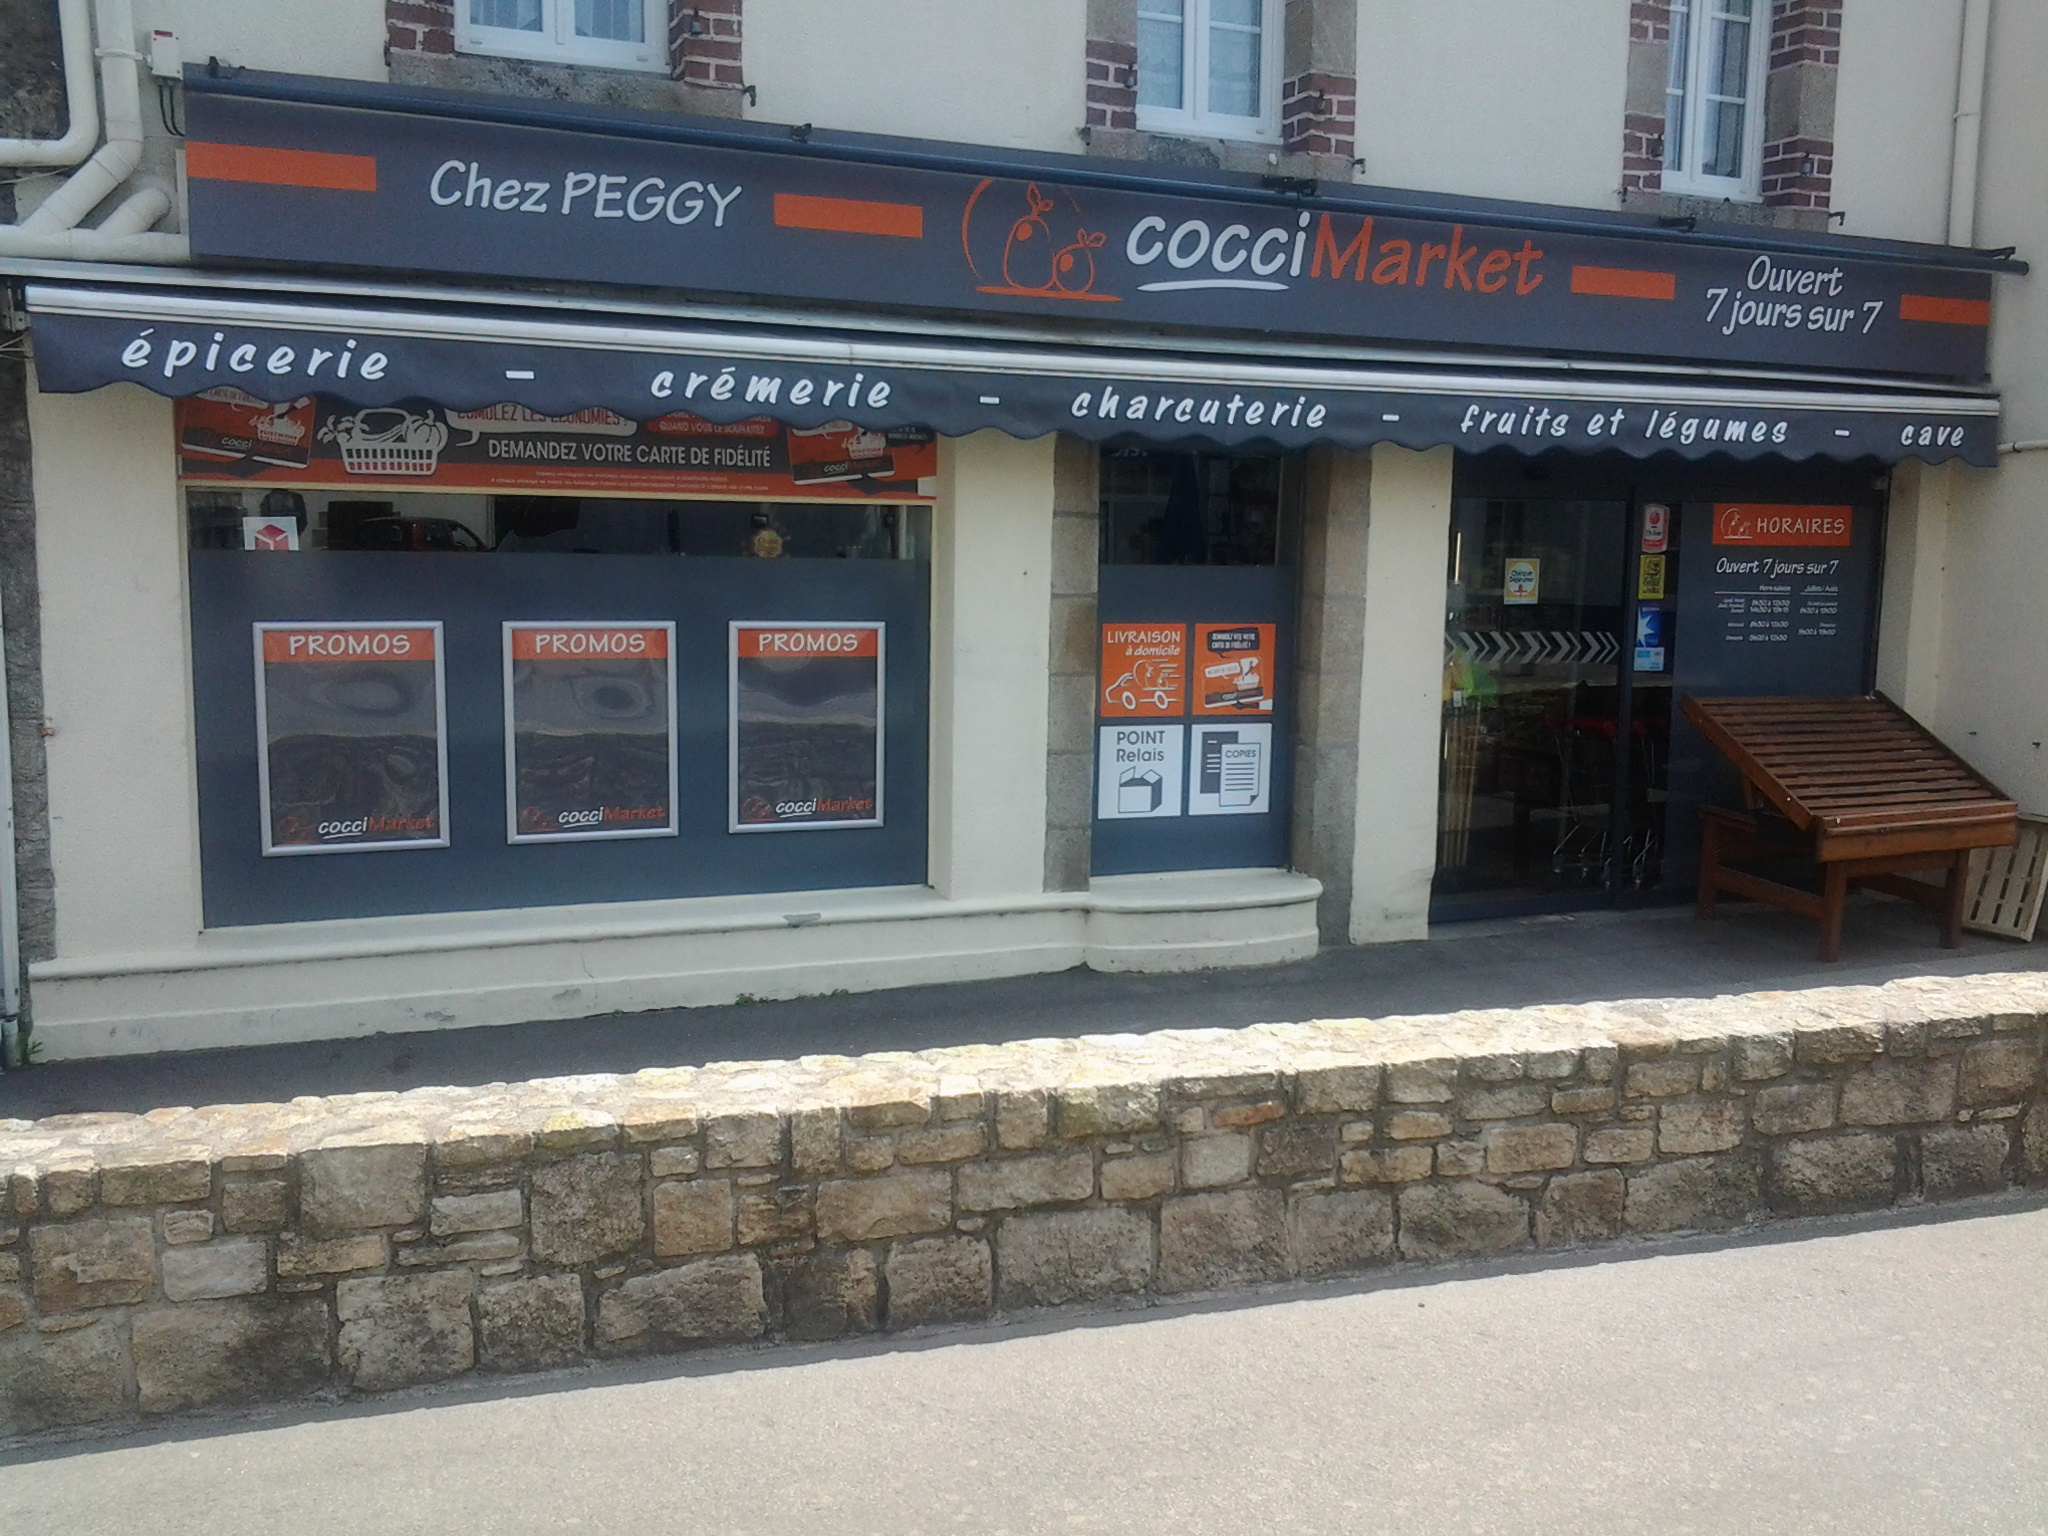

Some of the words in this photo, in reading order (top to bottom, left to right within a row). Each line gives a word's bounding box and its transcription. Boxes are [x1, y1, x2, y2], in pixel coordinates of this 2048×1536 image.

[431, 160, 549, 213] Chez
[561, 173, 742, 227] PEGGY
[1747, 255, 1843, 296] Ouvert
[1706, 287, 1728, 324] 7
[1722, 300, 1802, 335] jours
[1808, 306, 1854, 333] sur
[1862, 301, 1883, 334] 7
[121, 328, 390, 381] épicerie
[650, 365, 891, 408] crémerie
[1071, 386, 1328, 428] charcuterie
[1460, 404, 1568, 436] fruits
[1587, 408, 1625, 436] et
[1645, 408, 1788, 445] légumes
[1901, 424, 1964, 447] cave
[488, 439, 577, 460] DEMANDEZ
[580, 442, 632, 463] VOTRE
[636, 445, 686, 464] CARTE
[690, 446, 710, 466] DE
[714, 444, 771, 468] FIDÉLITÉ
[1757, 517, 1845, 534] HORAIRES
[1716, 557, 1759, 574] Ouvert
[1763, 558, 1773, 574] 7
[1770, 559, 1804, 578] jours
[1806, 563, 1828, 575] sur
[1829, 560, 1840, 575] 7
[289, 633, 411, 656] PROMOS
[535, 632, 646, 654] PROMOS
[758, 632, 859, 653] PROMOS
[1107, 630, 1181, 644] LIVRAISON
[1125, 645, 1133, 656] à
[1134, 644, 1181, 656] domicile
[1116, 730, 1166, 746] POINT
[1116, 748, 1165, 763] Relais
[1224, 749, 1257, 759] COPIES
